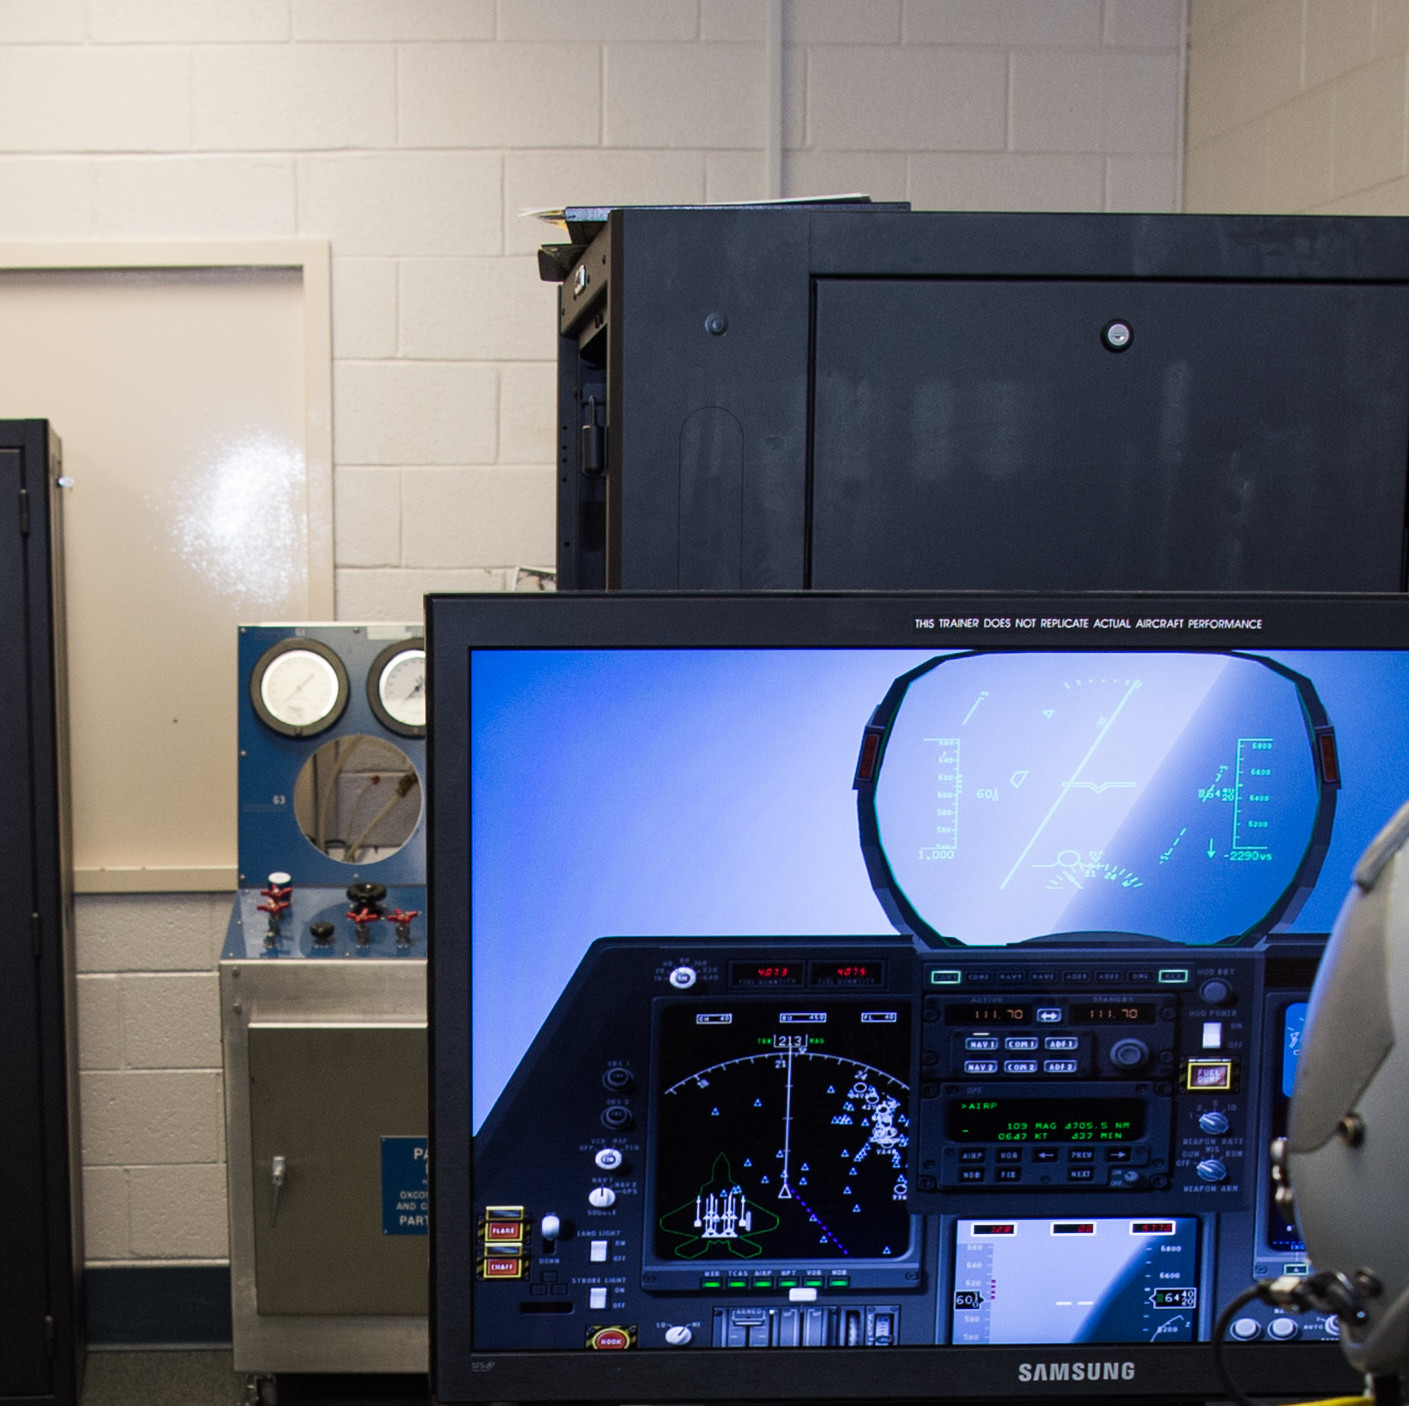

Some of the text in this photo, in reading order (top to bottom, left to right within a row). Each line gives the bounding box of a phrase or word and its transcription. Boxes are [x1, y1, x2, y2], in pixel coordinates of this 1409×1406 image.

[915, 618, 1262, 629] THIS TRAINER DOES NOT REPLICATE ACTUAL AIRCRAFT PERFORMANCE
[778, 1036, 802, 1046] 213
[970, 1040, 988, 1048] NAV
[854, 1070, 868, 1080] 24
[1035, 1122, 1057, 1130] MAG
[396, 1202, 416, 1210] AND
[1019, 1362, 1135, 1382] SAMSUNG
